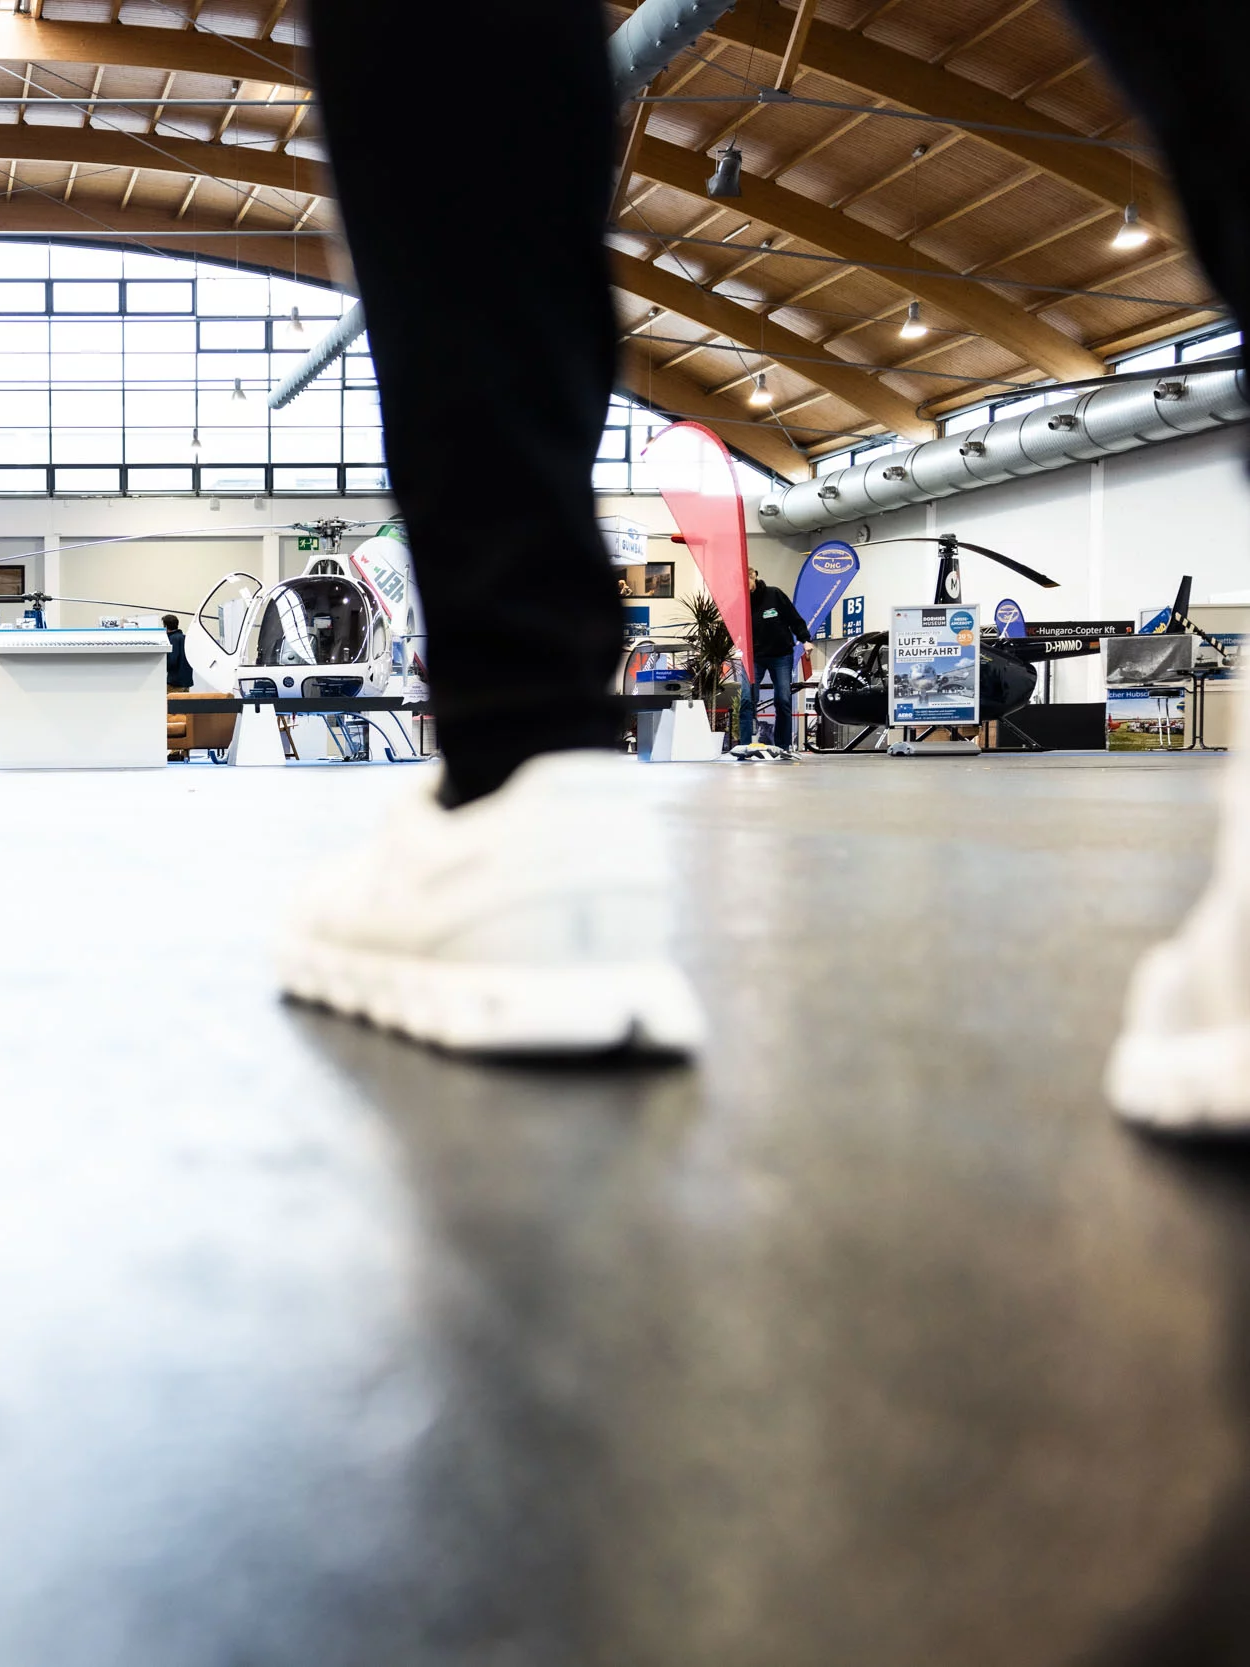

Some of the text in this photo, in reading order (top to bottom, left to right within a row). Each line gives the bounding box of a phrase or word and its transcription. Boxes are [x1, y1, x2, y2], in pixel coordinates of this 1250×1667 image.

[824, 561, 842, 569] DHC
[950, 577, 958, 591] M
[847, 597, 863, 615] B5
[1104, 626, 1116, 634] Kft
[898, 636, 936, 646] LUFT- &
[1045, 639, 1083, 653] D-HMMO
[898, 647, 959, 657] RAUMFAHRT
